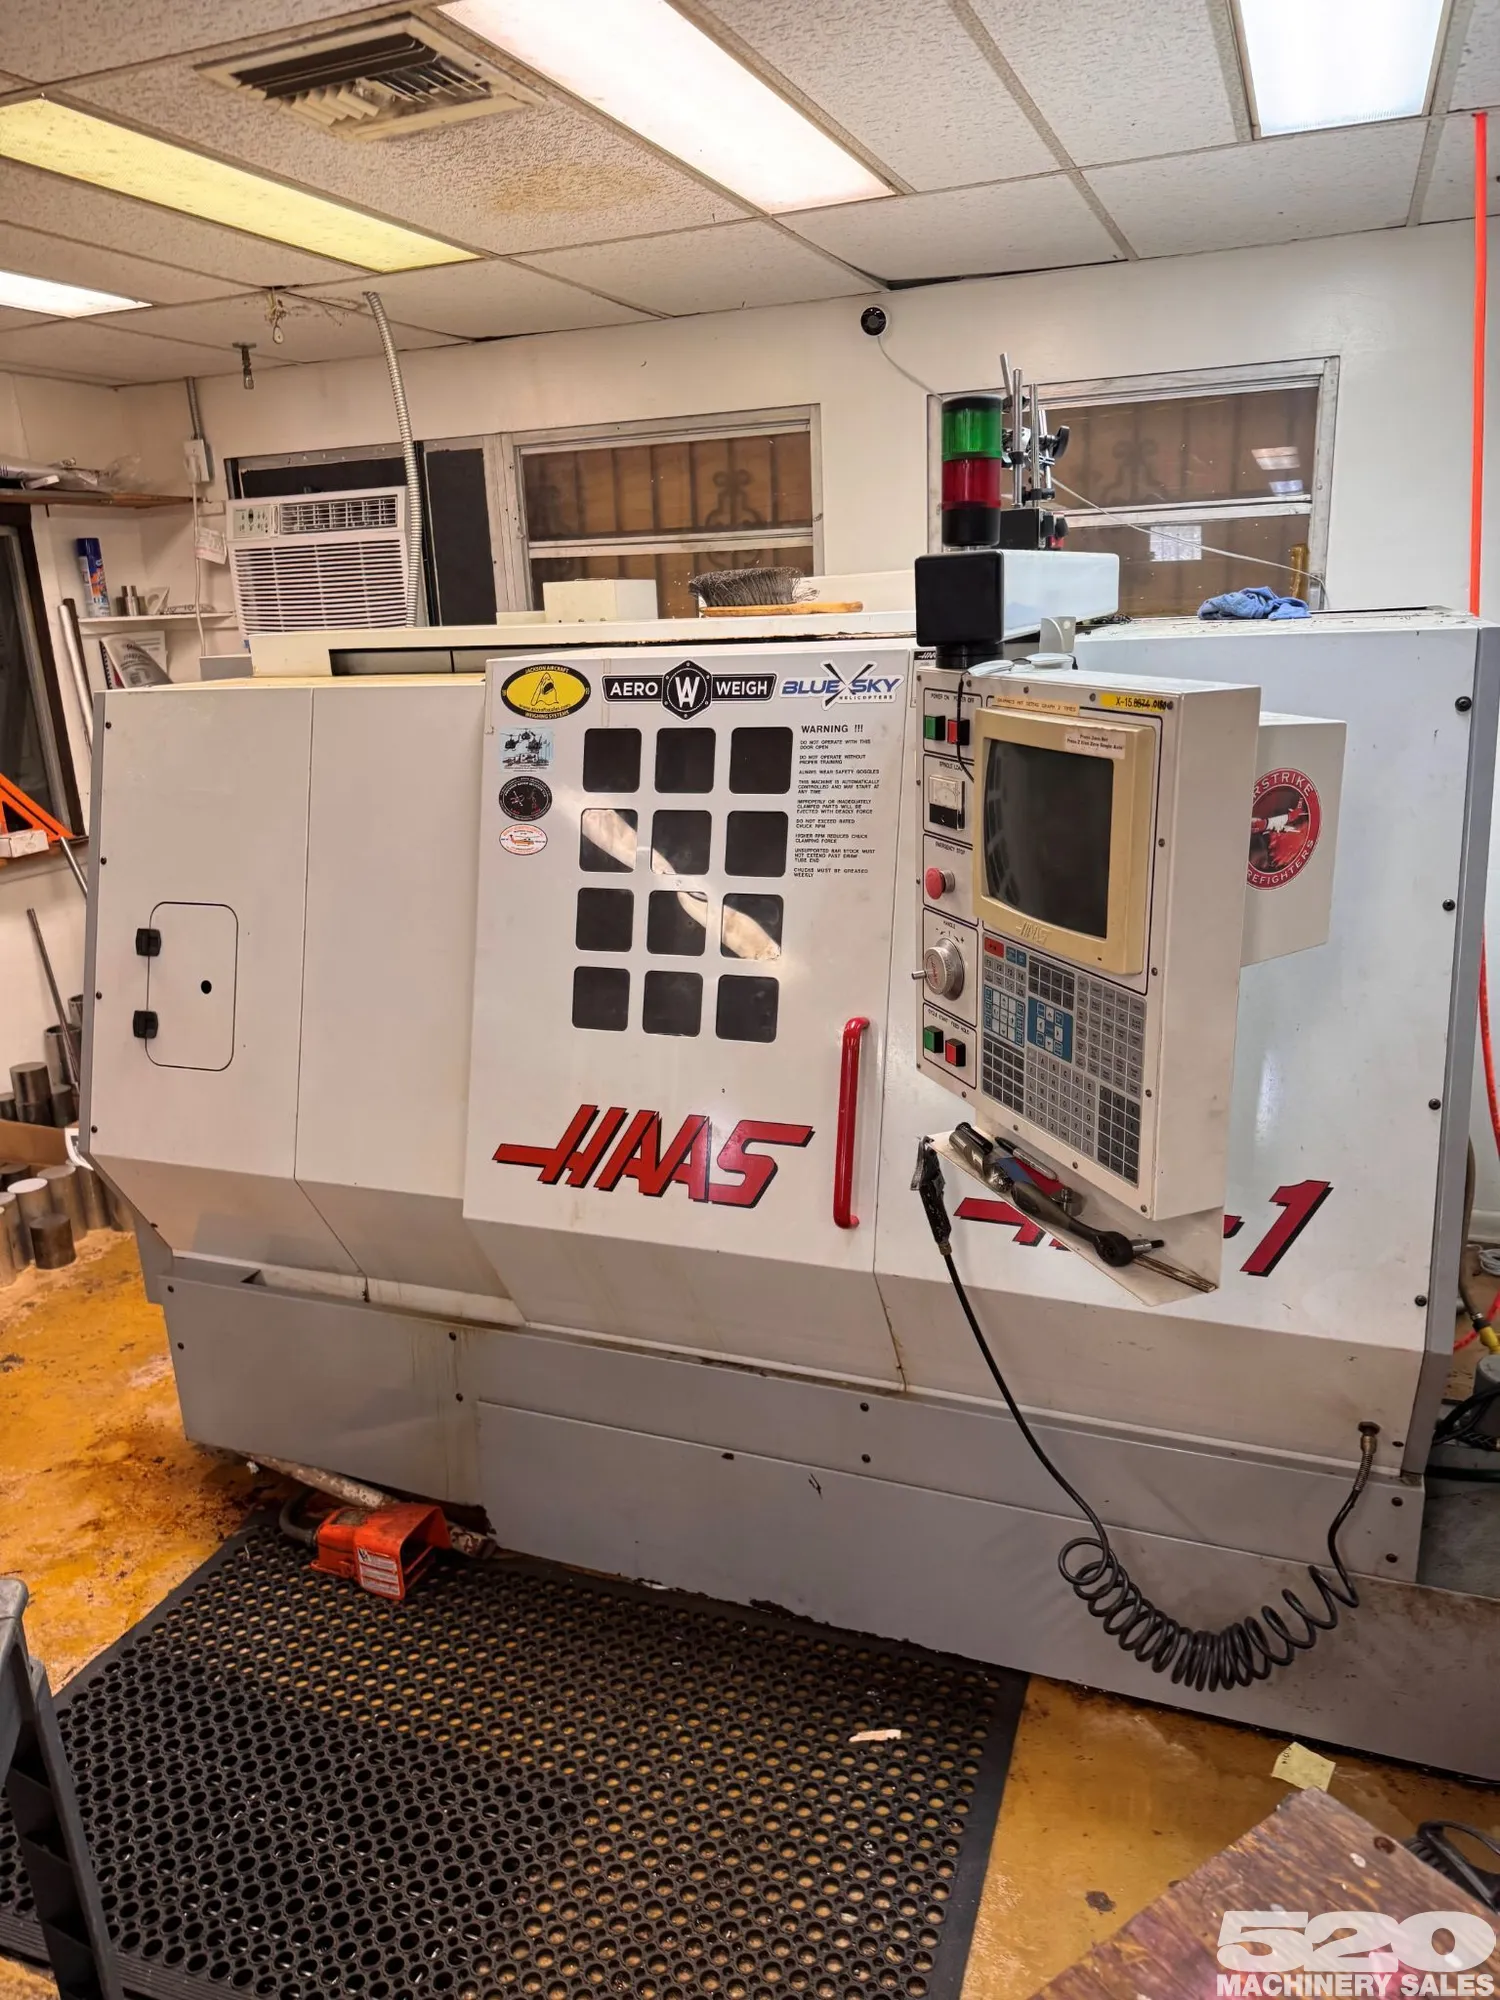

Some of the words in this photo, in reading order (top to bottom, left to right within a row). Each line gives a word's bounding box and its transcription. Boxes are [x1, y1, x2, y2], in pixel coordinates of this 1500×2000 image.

[525, 665, 546, 674] JACKSON
[547, 665, 570, 674] AIRCRAFT
[610, 682, 658, 696] AERO
[715, 680, 768, 696] WEIGH
[782, 679, 840, 695] BLUE
[852, 678, 900, 694] SKY
[801, 724, 849, 734] WARNING
[854, 724, 864, 733] !!!
[492, 1104, 814, 1208] HAAS
